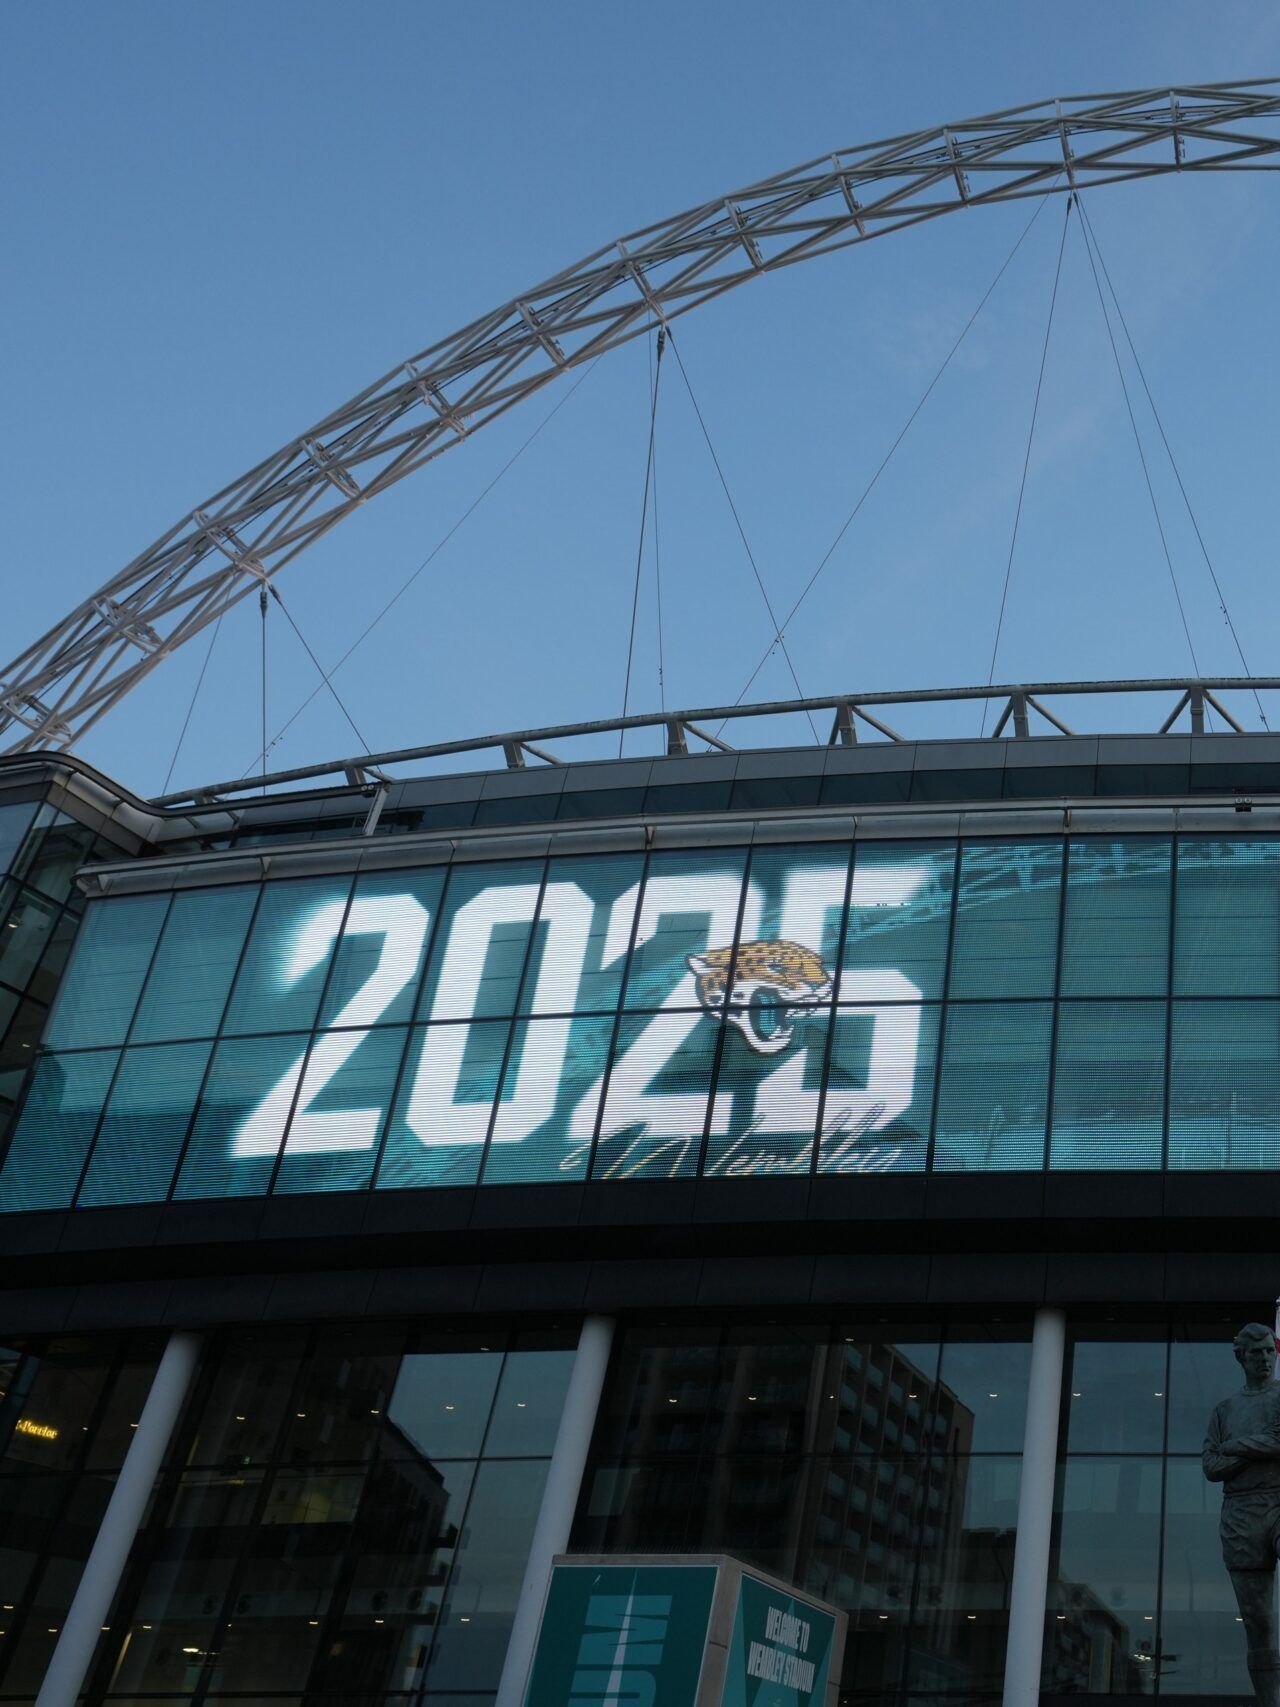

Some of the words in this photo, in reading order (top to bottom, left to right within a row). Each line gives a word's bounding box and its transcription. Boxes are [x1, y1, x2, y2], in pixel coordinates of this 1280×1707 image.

[230, 864, 934, 1160] 2025
[765, 1606, 802, 1650] WELCOME
[799, 1620, 811, 1653] TO
[747, 1640, 786, 1684] WEMBLEY
[783, 1654, 816, 1694] STADIUM
